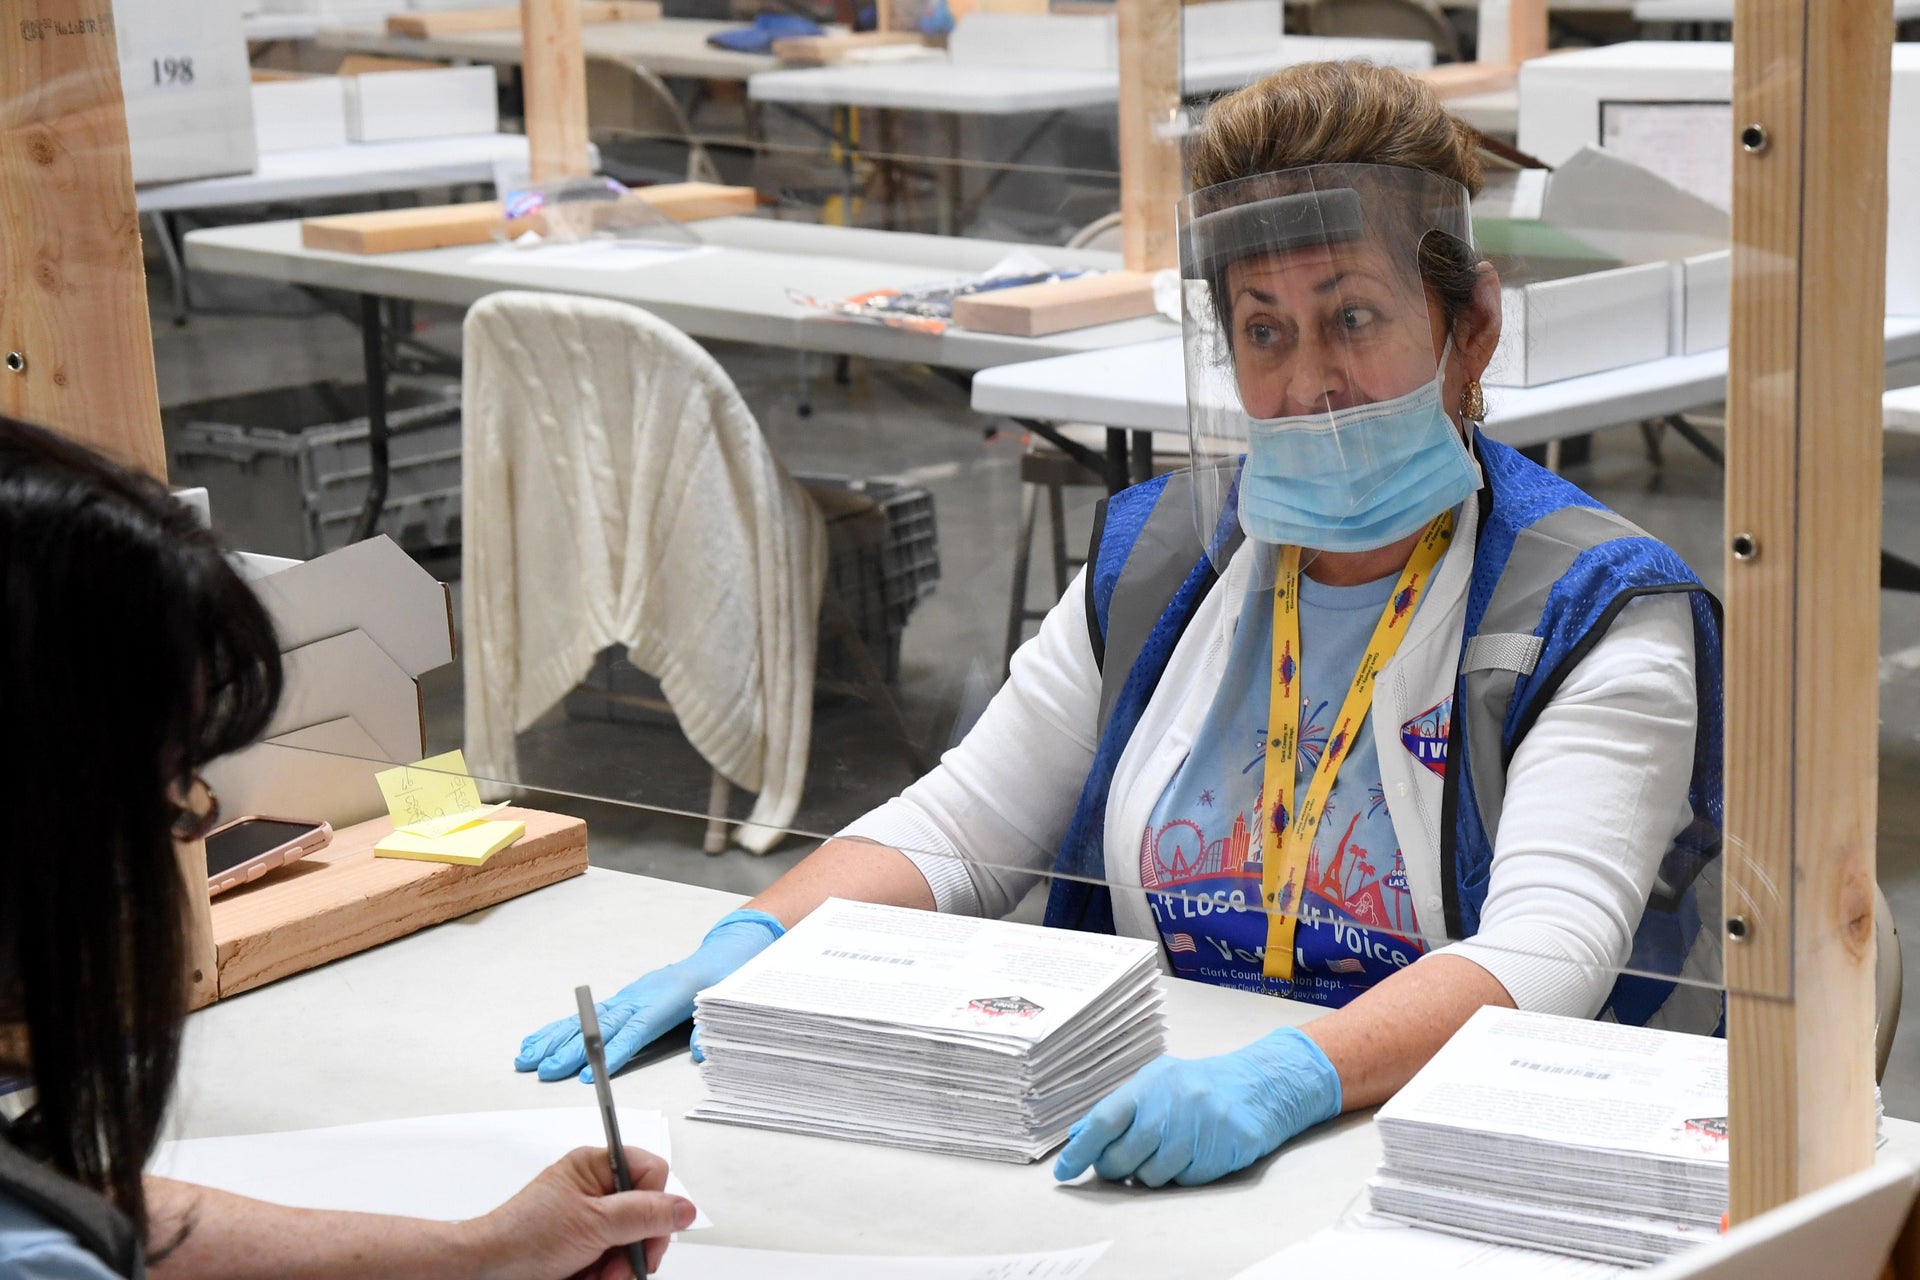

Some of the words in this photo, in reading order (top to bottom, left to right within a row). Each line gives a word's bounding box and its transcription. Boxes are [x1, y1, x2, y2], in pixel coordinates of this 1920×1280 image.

[152, 56, 194, 86] 198
[1418, 741, 1425, 758] I
[1181, 889, 1247, 918] Lose
[1329, 908, 1410, 970] Voice
[1200, 967, 1228, 979] Clark
[1315, 977, 1345, 991] Dept.
